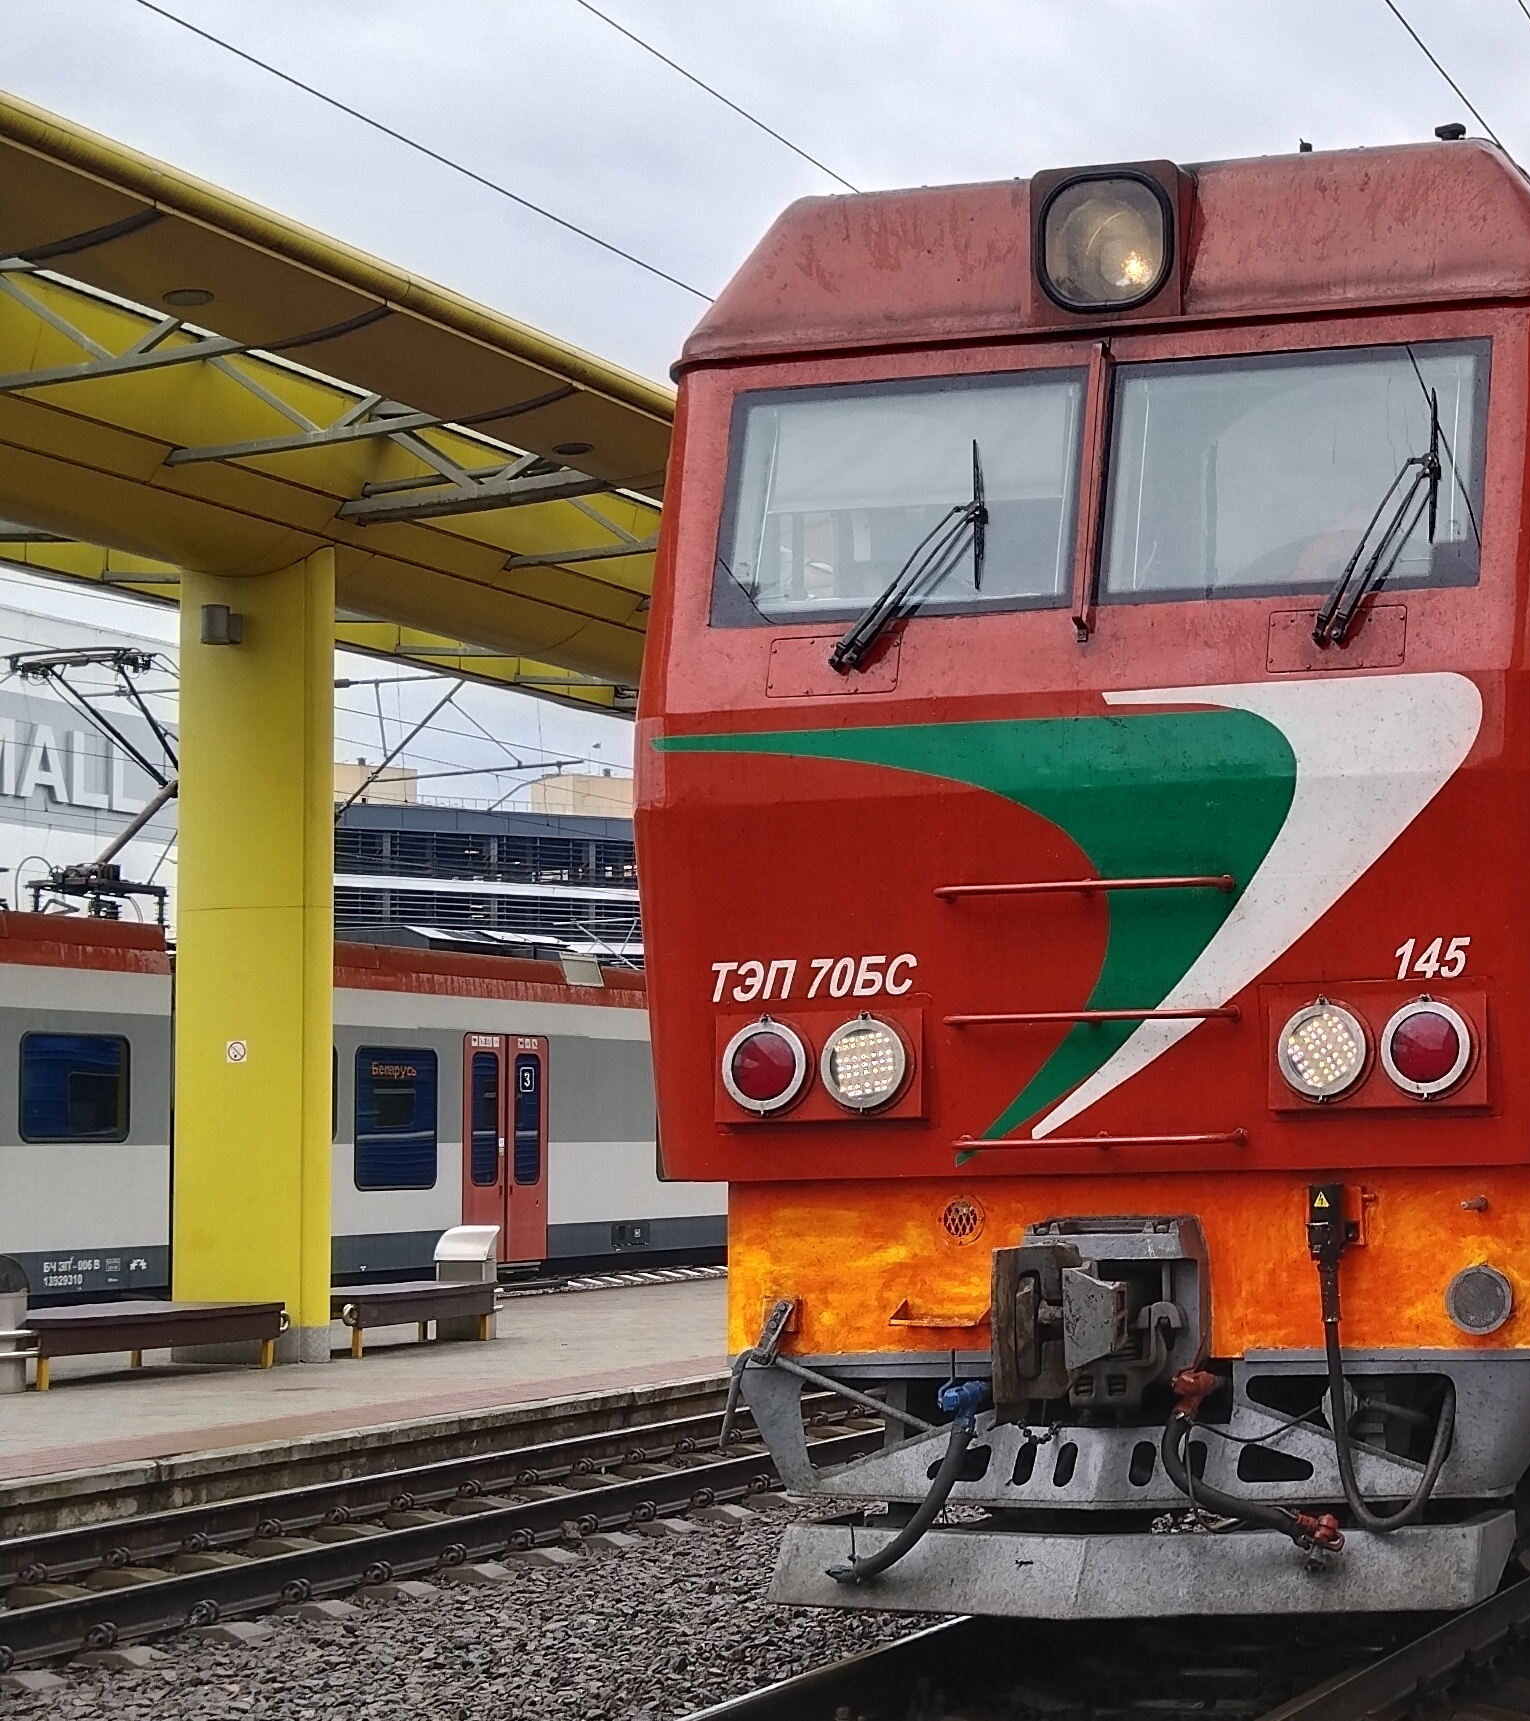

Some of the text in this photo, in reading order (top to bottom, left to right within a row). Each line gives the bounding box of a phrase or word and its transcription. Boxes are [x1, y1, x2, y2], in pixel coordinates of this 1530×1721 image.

[1395, 937, 1471, 980] 145
[711, 953, 918, 1003] ТЭП 70БС
[371, 1062, 417, 1079] Беларусь
[523, 1071, 531, 1088] 3
